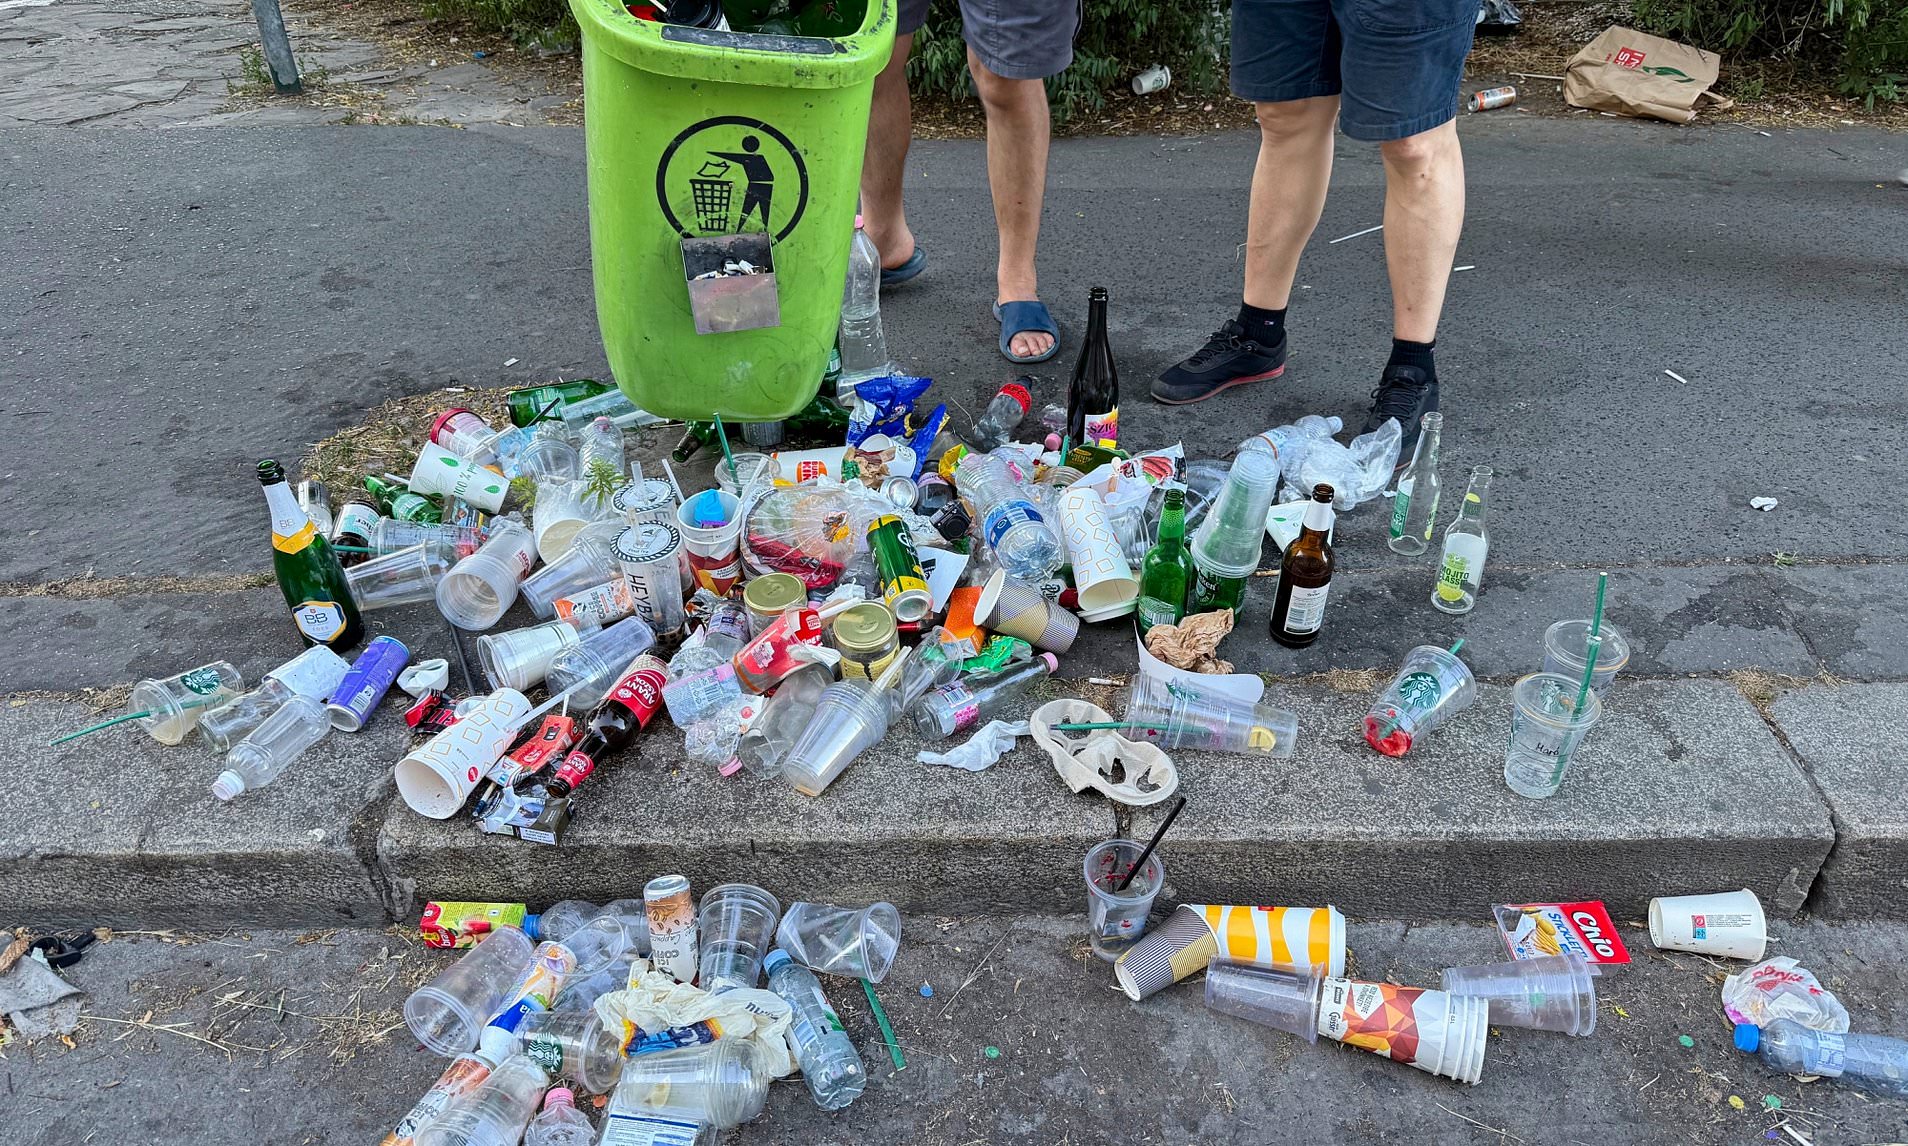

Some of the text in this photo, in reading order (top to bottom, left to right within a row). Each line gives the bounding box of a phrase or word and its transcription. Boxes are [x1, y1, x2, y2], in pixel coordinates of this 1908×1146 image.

[803, 461, 811, 481] KIN
[453, 479, 468, 496] 100
[627, 572, 654, 627] HEYBA
[304, 612, 328, 625] BB
[624, 681, 656, 706] ARANY
[438, 929, 451, 947] bravo
[1572, 911, 1615, 958] Chio
